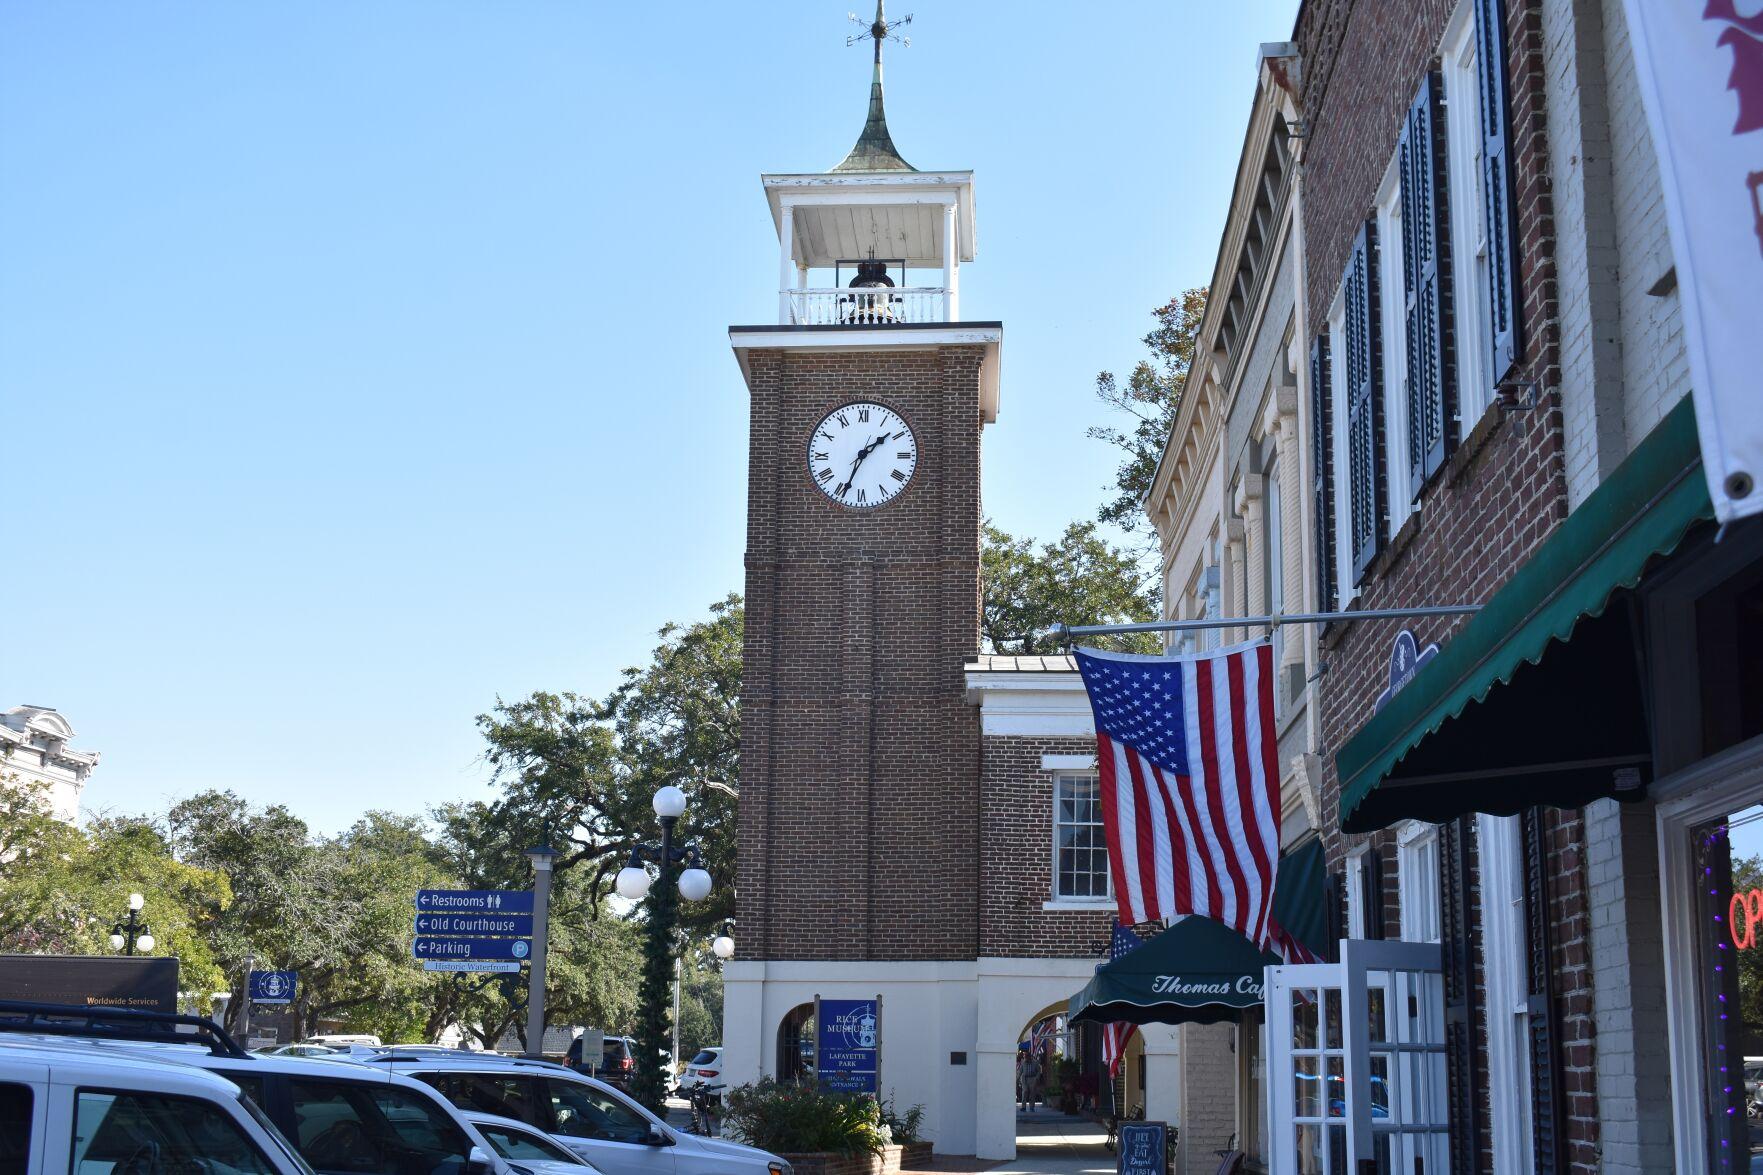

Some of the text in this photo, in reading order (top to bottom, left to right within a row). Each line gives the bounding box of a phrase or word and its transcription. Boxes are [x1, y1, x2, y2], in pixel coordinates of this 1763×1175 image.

[858, 409, 869, 422] XII
[431, 894, 484, 907] Restrooms
[430, 918, 515, 931] Old Courthouse
[429, 942, 471, 957] Parking
[435, 963, 509, 971] Historic Waterfront
[1152, 975, 1265, 1000] Thomas Caf
[87, 997, 158, 1005] Worldwide Services
[836, 1015, 858, 1023] RICE
